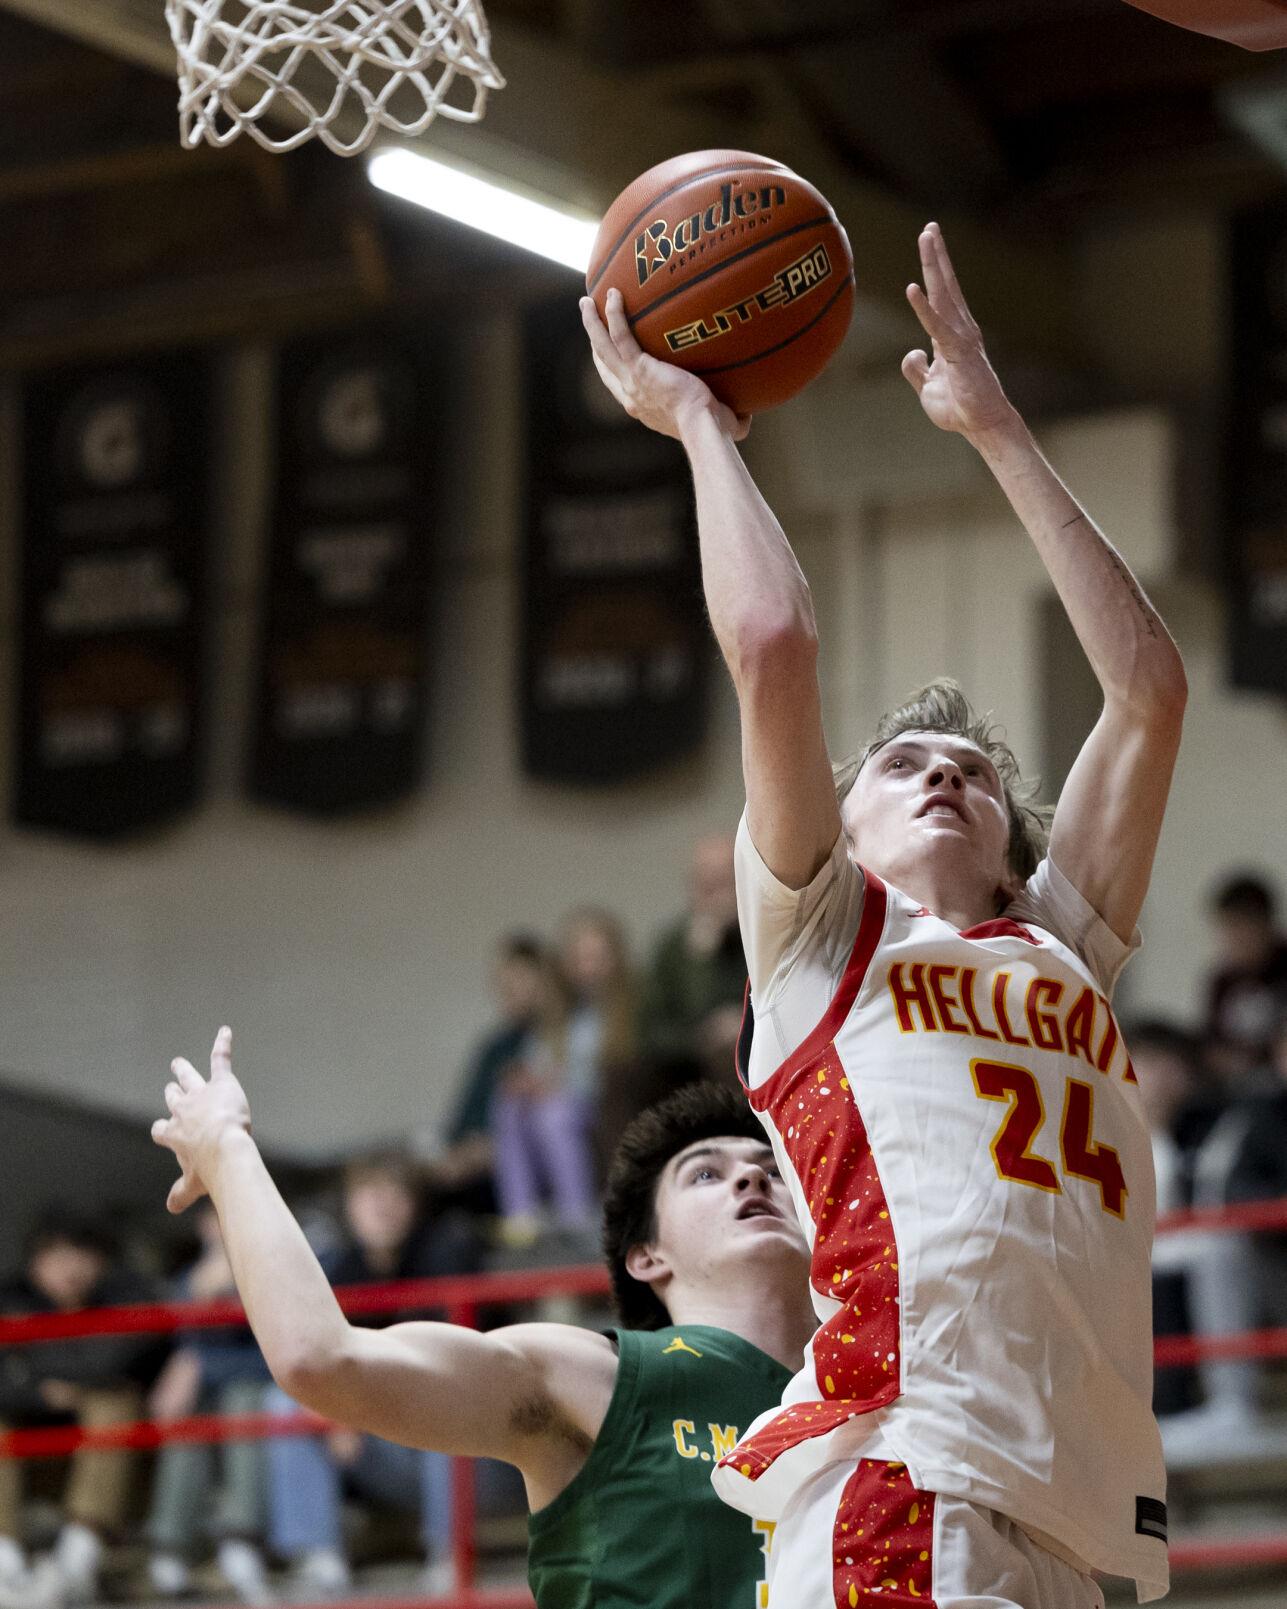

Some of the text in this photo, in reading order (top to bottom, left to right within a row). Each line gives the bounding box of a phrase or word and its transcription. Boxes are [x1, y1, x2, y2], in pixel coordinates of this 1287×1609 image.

[634, 181, 786, 288] Baden
[669, 214, 773, 275] PERFECTION
[664, 246, 832, 352] ELITE PRO
[887, 961, 1139, 1087] HELLGAT
[968, 1057, 1130, 1222] 24
